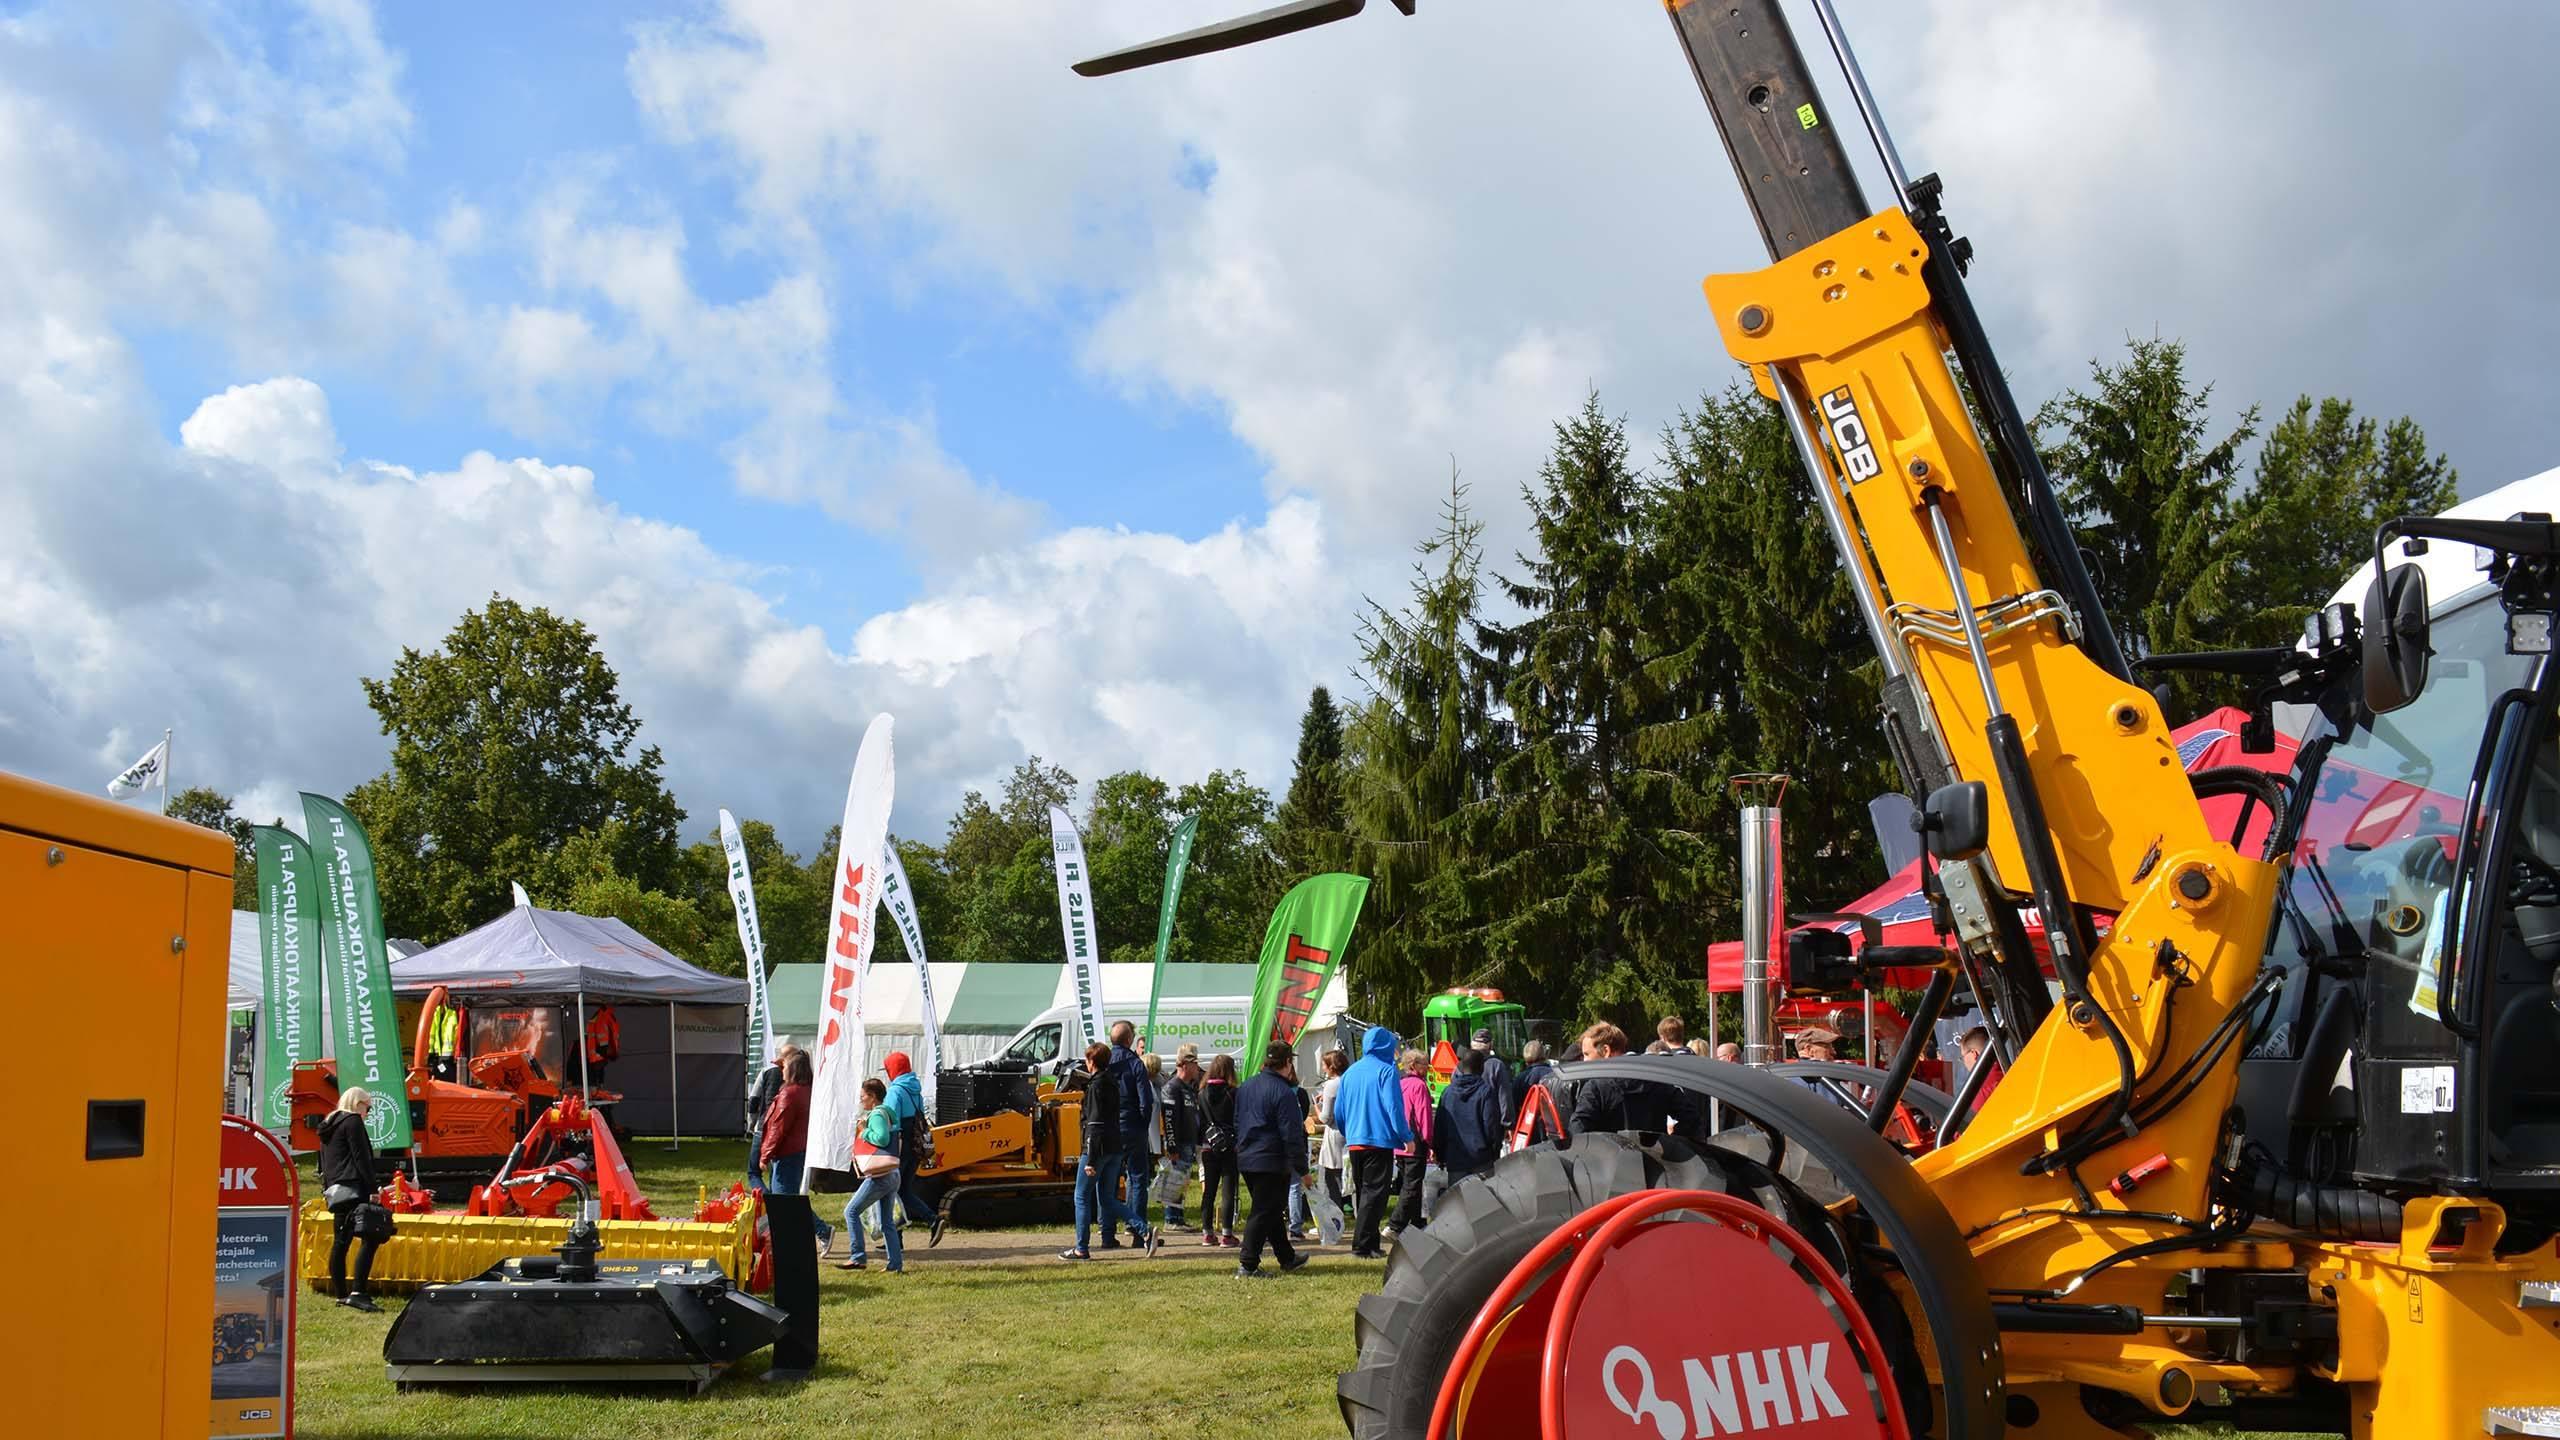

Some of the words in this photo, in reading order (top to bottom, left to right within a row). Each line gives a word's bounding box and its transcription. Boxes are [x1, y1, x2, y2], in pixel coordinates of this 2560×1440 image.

[1822, 392, 1879, 482] JCB
[829, 855, 864, 1016] NHK
[1210, 1038, 1244, 1048] .com
[1165, 1109, 1176, 1147] RACING
[989, 1139, 1012, 1149] TRX
[222, 1233, 268, 1243] ketterän
[1682, 1341, 1849, 1439] NHK
[240, 1410, 271, 1420] JCB
